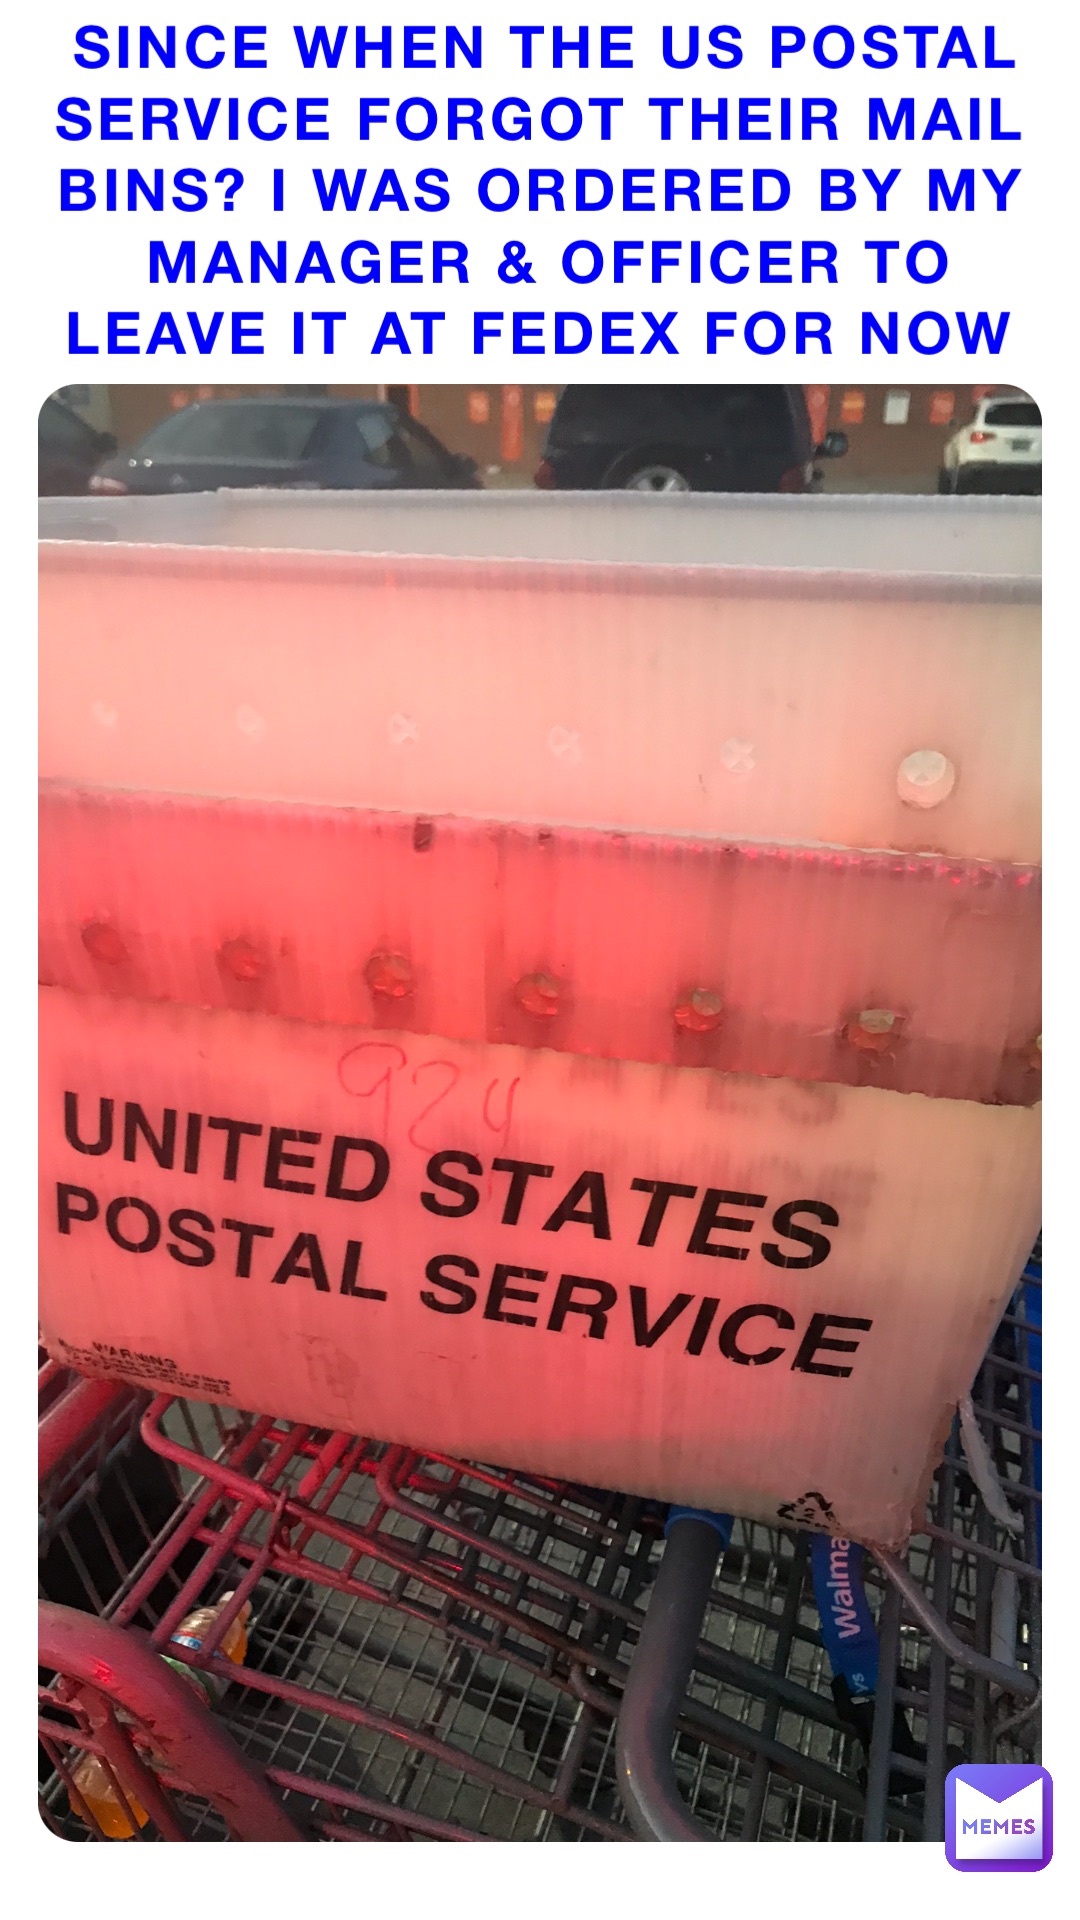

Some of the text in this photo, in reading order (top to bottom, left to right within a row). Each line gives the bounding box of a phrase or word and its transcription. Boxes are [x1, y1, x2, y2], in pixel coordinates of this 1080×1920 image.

[337, 1042, 521, 1156] 924
[62, 1090, 841, 1270] UNITED STATES
[55, 1182, 874, 1379] POSTAL SERVICE
[92, 1341, 178, 1369] WARNING
